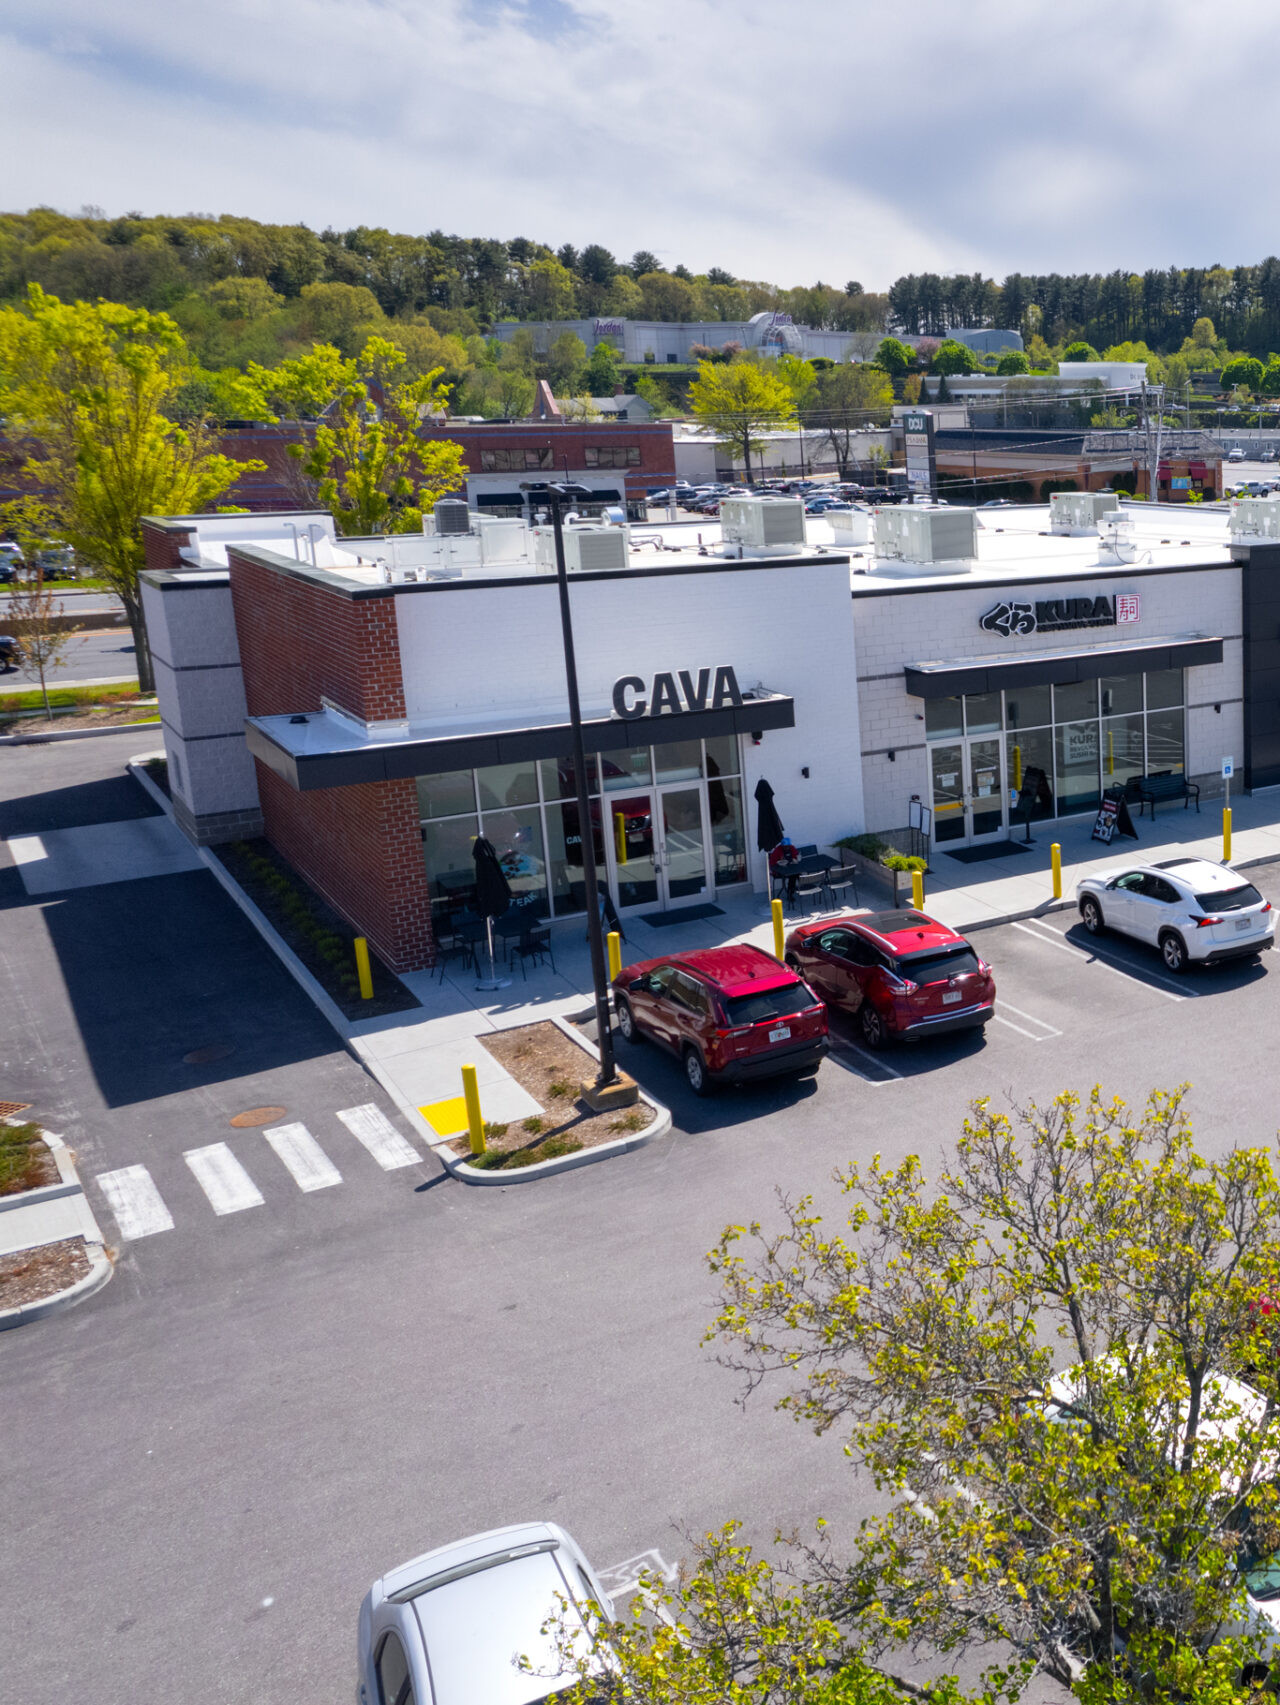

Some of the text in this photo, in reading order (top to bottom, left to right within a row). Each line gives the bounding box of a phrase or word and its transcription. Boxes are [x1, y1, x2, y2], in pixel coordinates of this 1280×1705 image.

[1035, 596, 1114, 624] KURA
[612, 665, 743, 720] CAVA
[566, 835, 582, 844] CAV
[508, 893, 538, 907] TEAK
